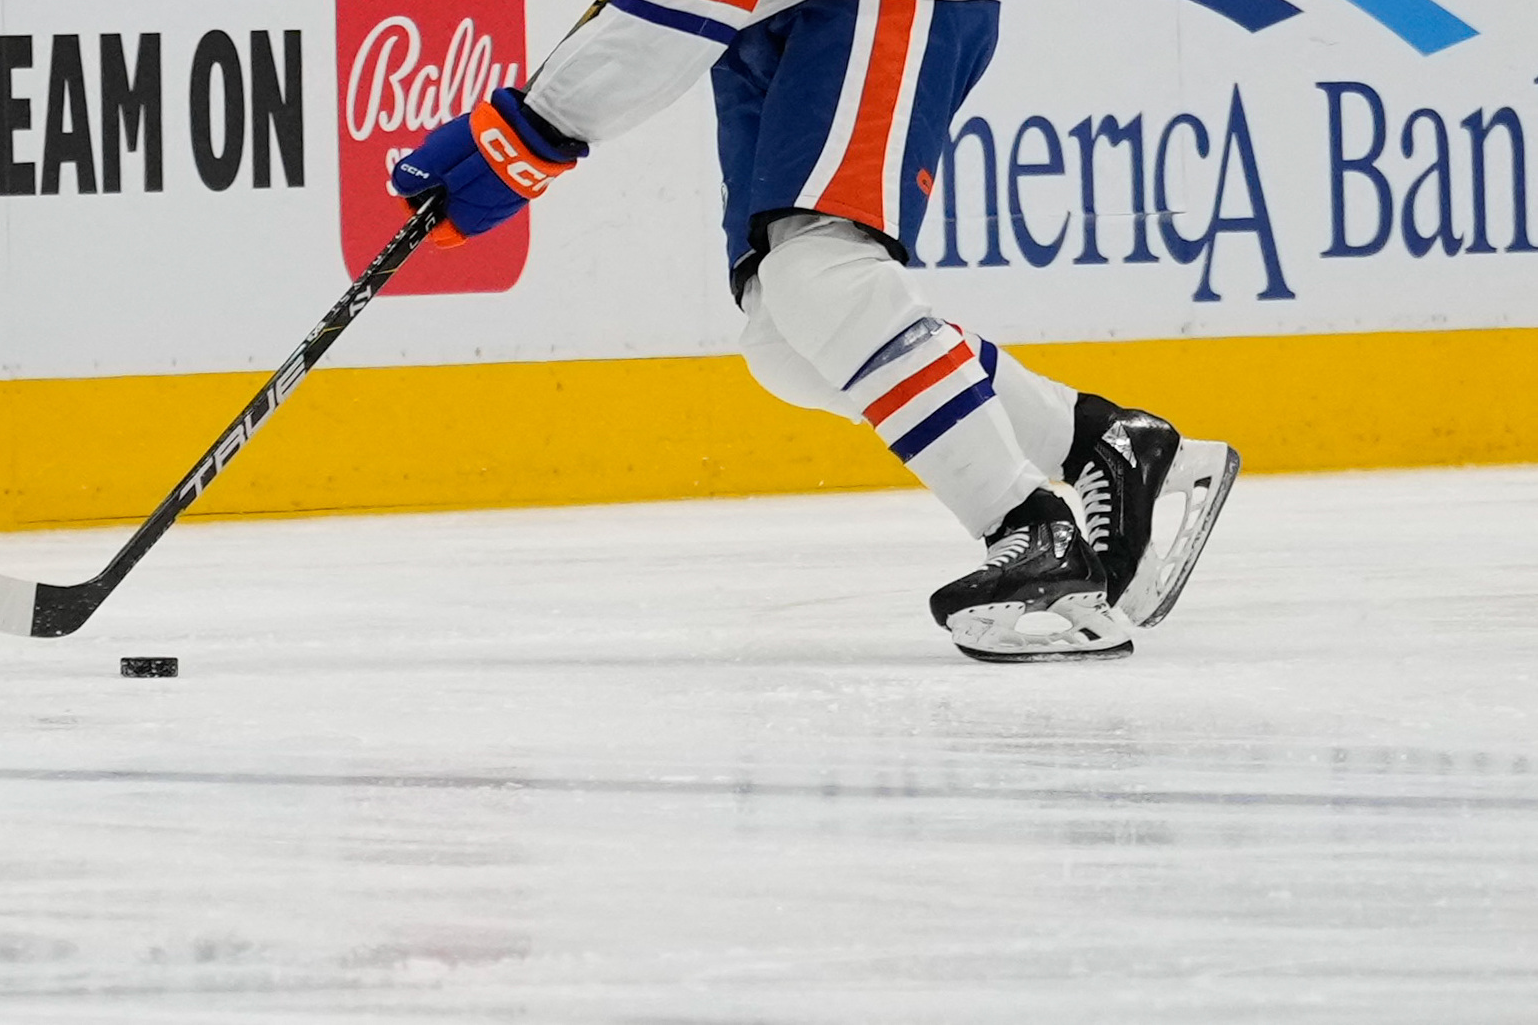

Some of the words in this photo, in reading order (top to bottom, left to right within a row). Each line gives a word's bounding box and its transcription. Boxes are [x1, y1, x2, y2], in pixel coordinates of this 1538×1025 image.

[189, 28, 306, 192] ON
[399, 162, 430, 180] CCM
[1315, 75, 1538, 259] Ban
[178, 353, 307, 498] TRUE
